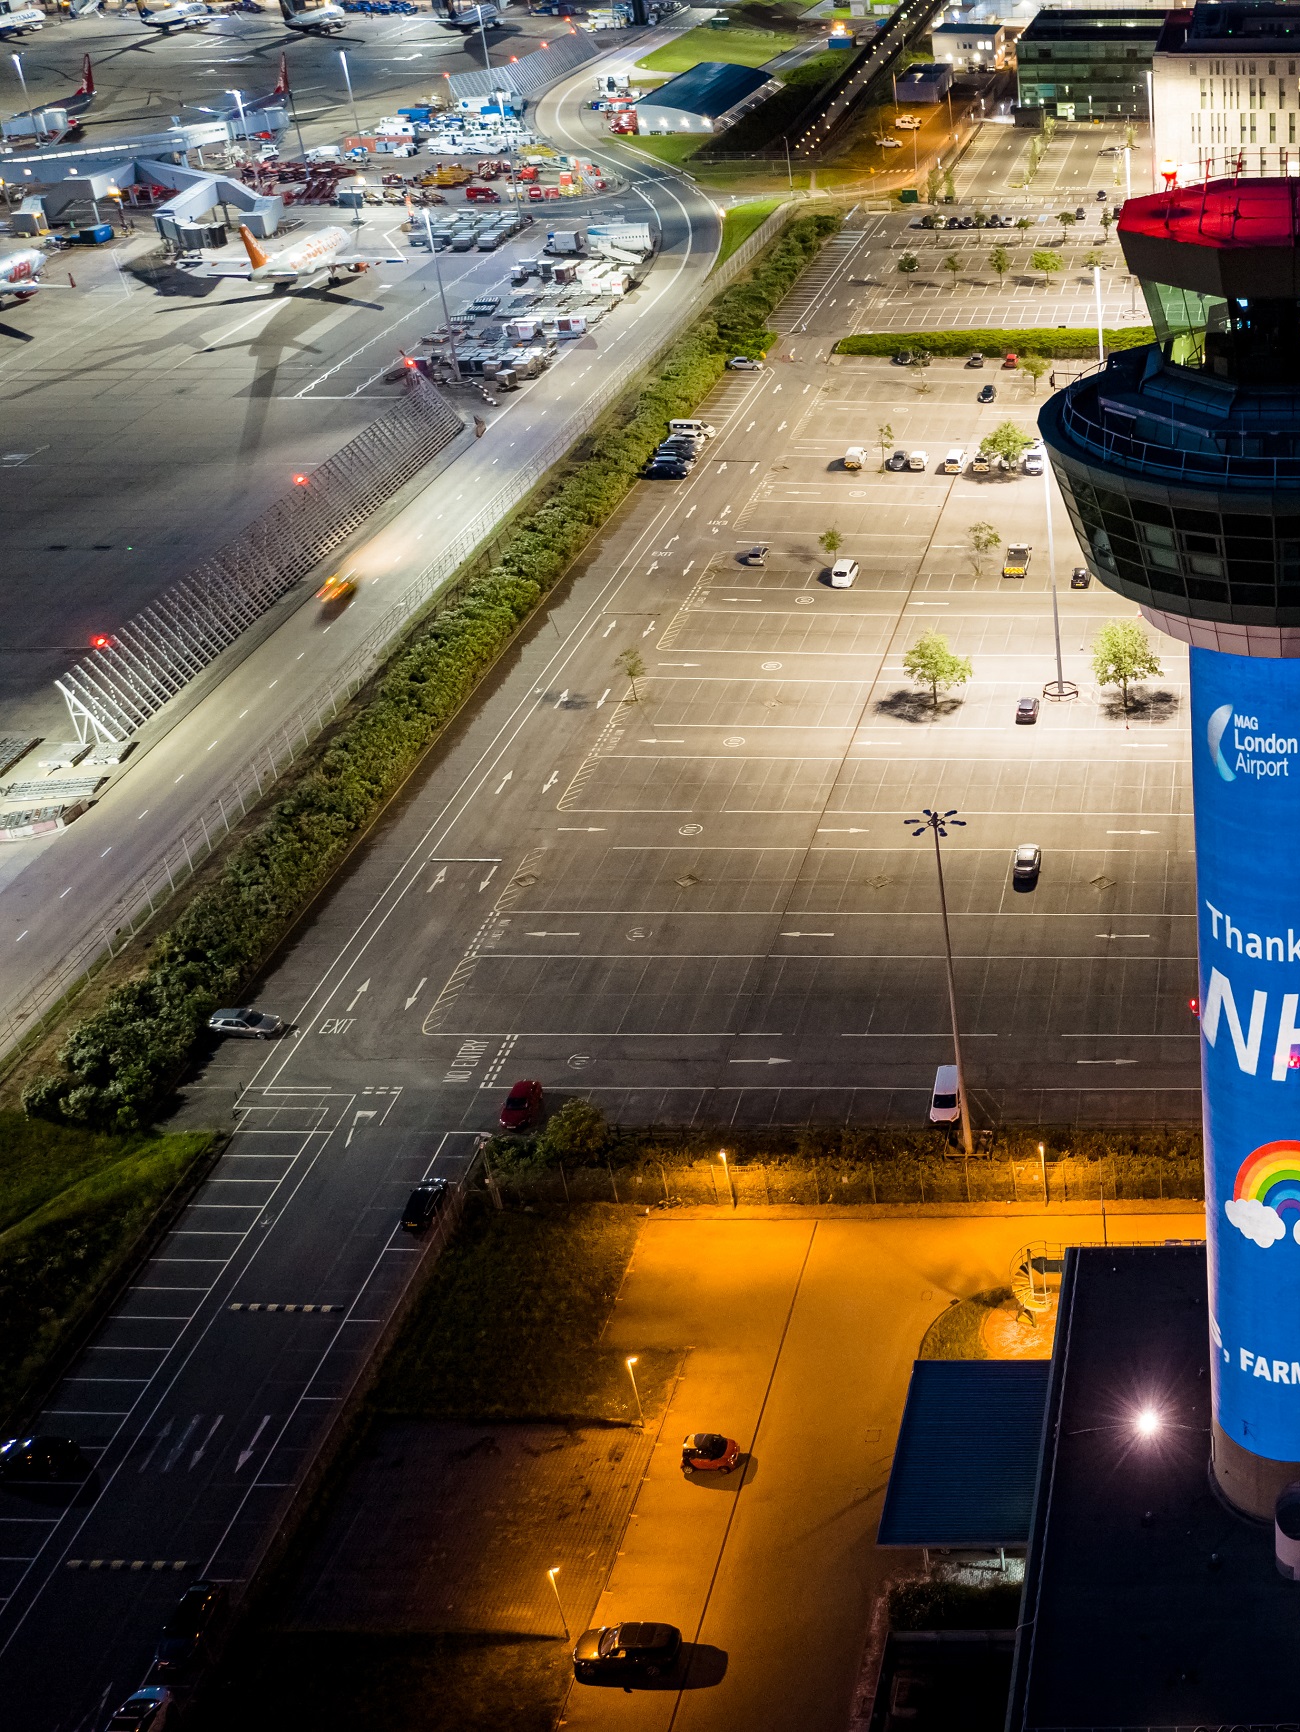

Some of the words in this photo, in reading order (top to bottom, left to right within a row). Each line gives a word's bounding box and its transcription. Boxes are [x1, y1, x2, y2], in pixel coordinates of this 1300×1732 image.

[1234, 714, 1259, 731] MAG
[1234, 729, 1298, 754] London
[1235, 752, 1289, 780] Airport
[319, 1018, 357, 1034] EXIT
[451, 1039, 490, 1067] ENTRY
[443, 1070, 473, 1083] NO
